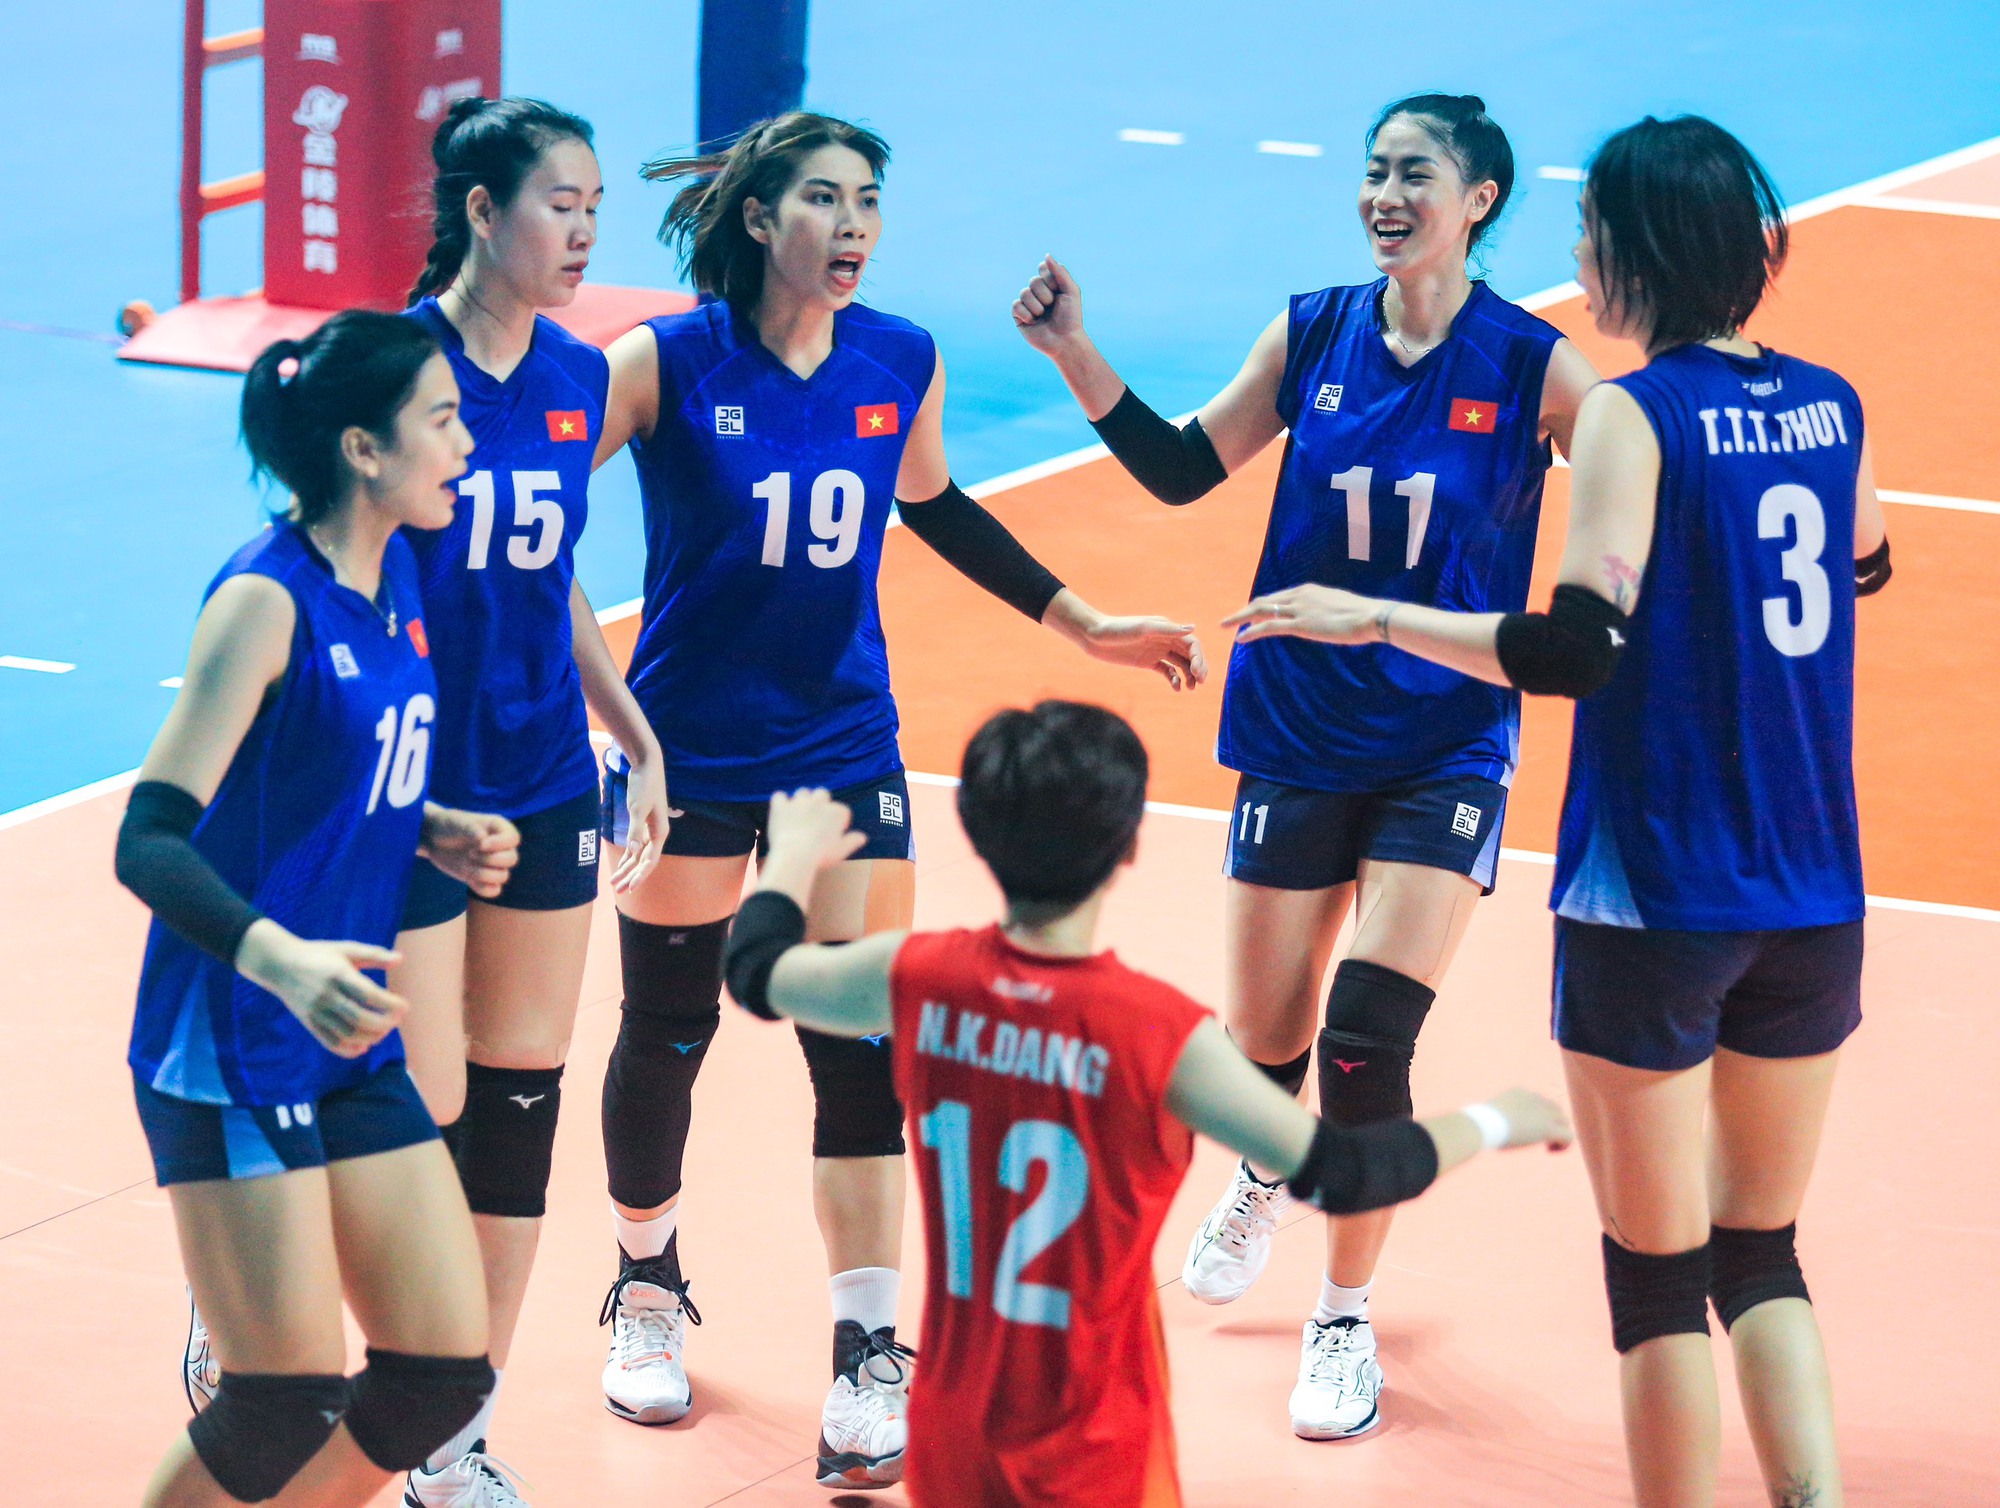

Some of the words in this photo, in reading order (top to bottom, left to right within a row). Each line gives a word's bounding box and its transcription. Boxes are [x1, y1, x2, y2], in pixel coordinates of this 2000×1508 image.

[1699, 401, 1848, 455] T.T.T.THUY
[458, 469, 565, 571] 15
[752, 468, 866, 569] 19
[1330, 465, 1437, 570] 11
[1757, 483, 1831, 657] 3
[365, 693, 436, 815] 16
[1239, 801, 1269, 845] 11
[916, 1001, 1109, 1098] N.K.DANG
[919, 1100, 1090, 1329] 12
